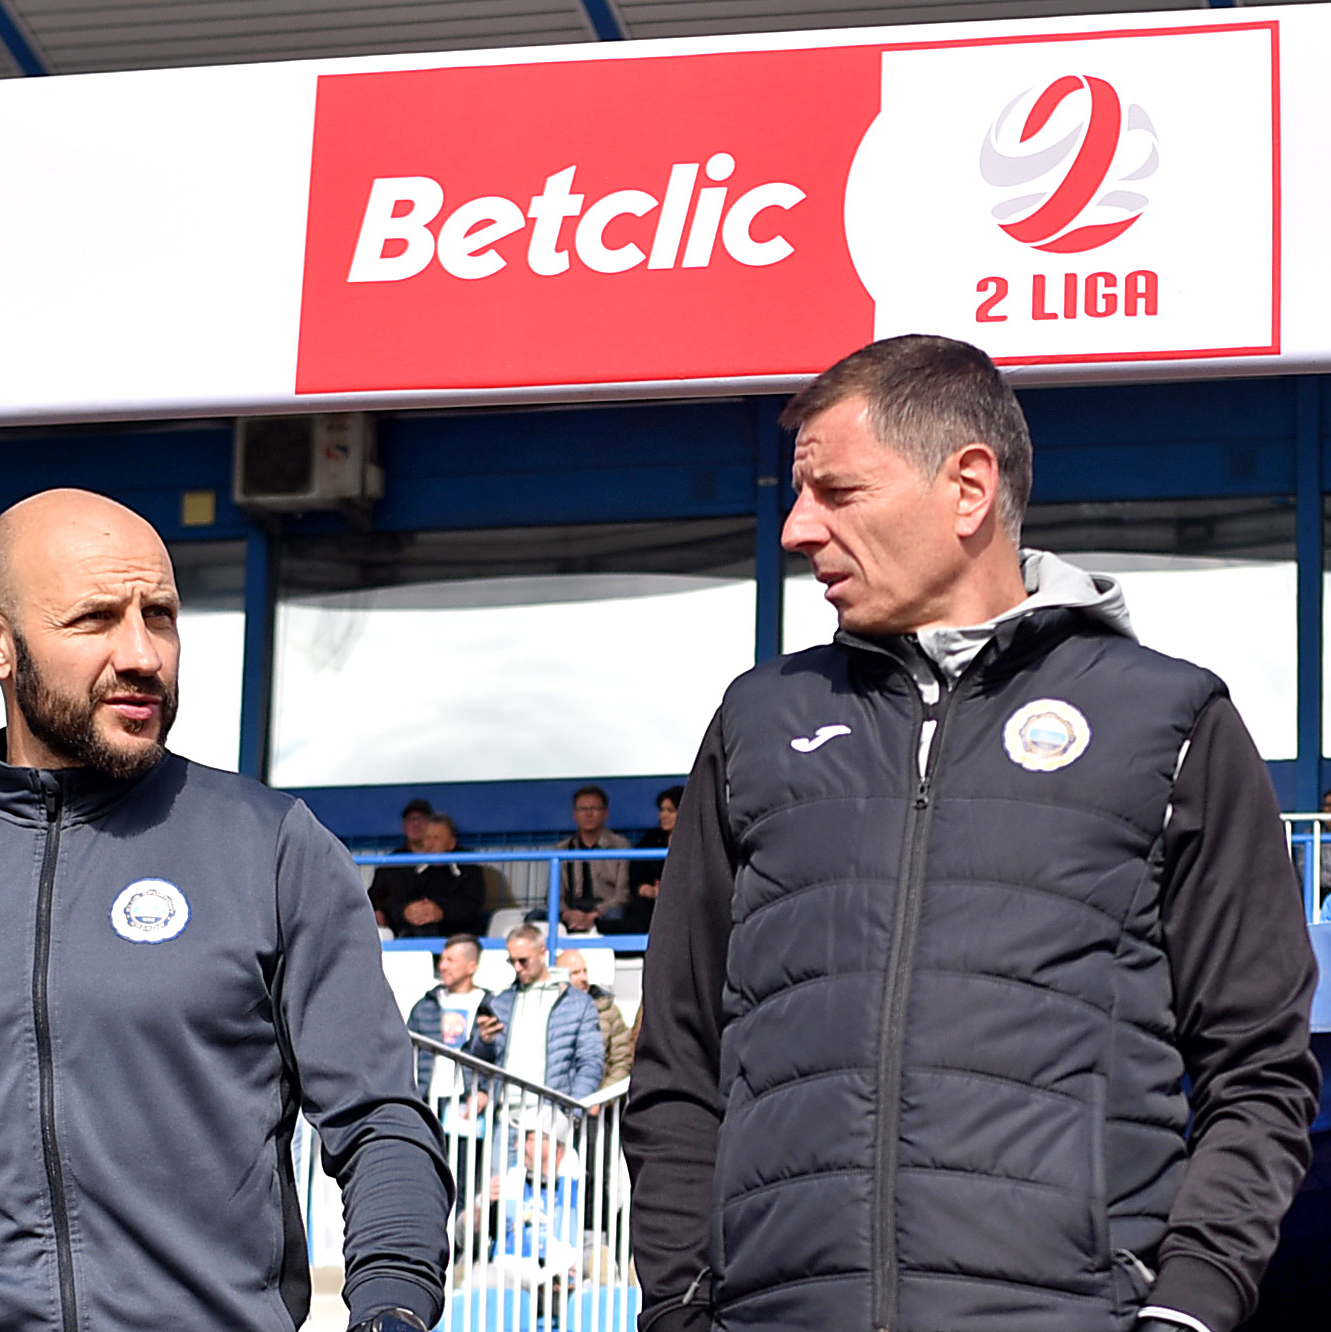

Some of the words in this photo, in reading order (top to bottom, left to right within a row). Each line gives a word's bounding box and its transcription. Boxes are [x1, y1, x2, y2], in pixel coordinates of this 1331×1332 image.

[345, 152, 807, 283] Betclic
[975, 275, 1009, 324] 2
[1031, 269, 1159, 321] LIGA
